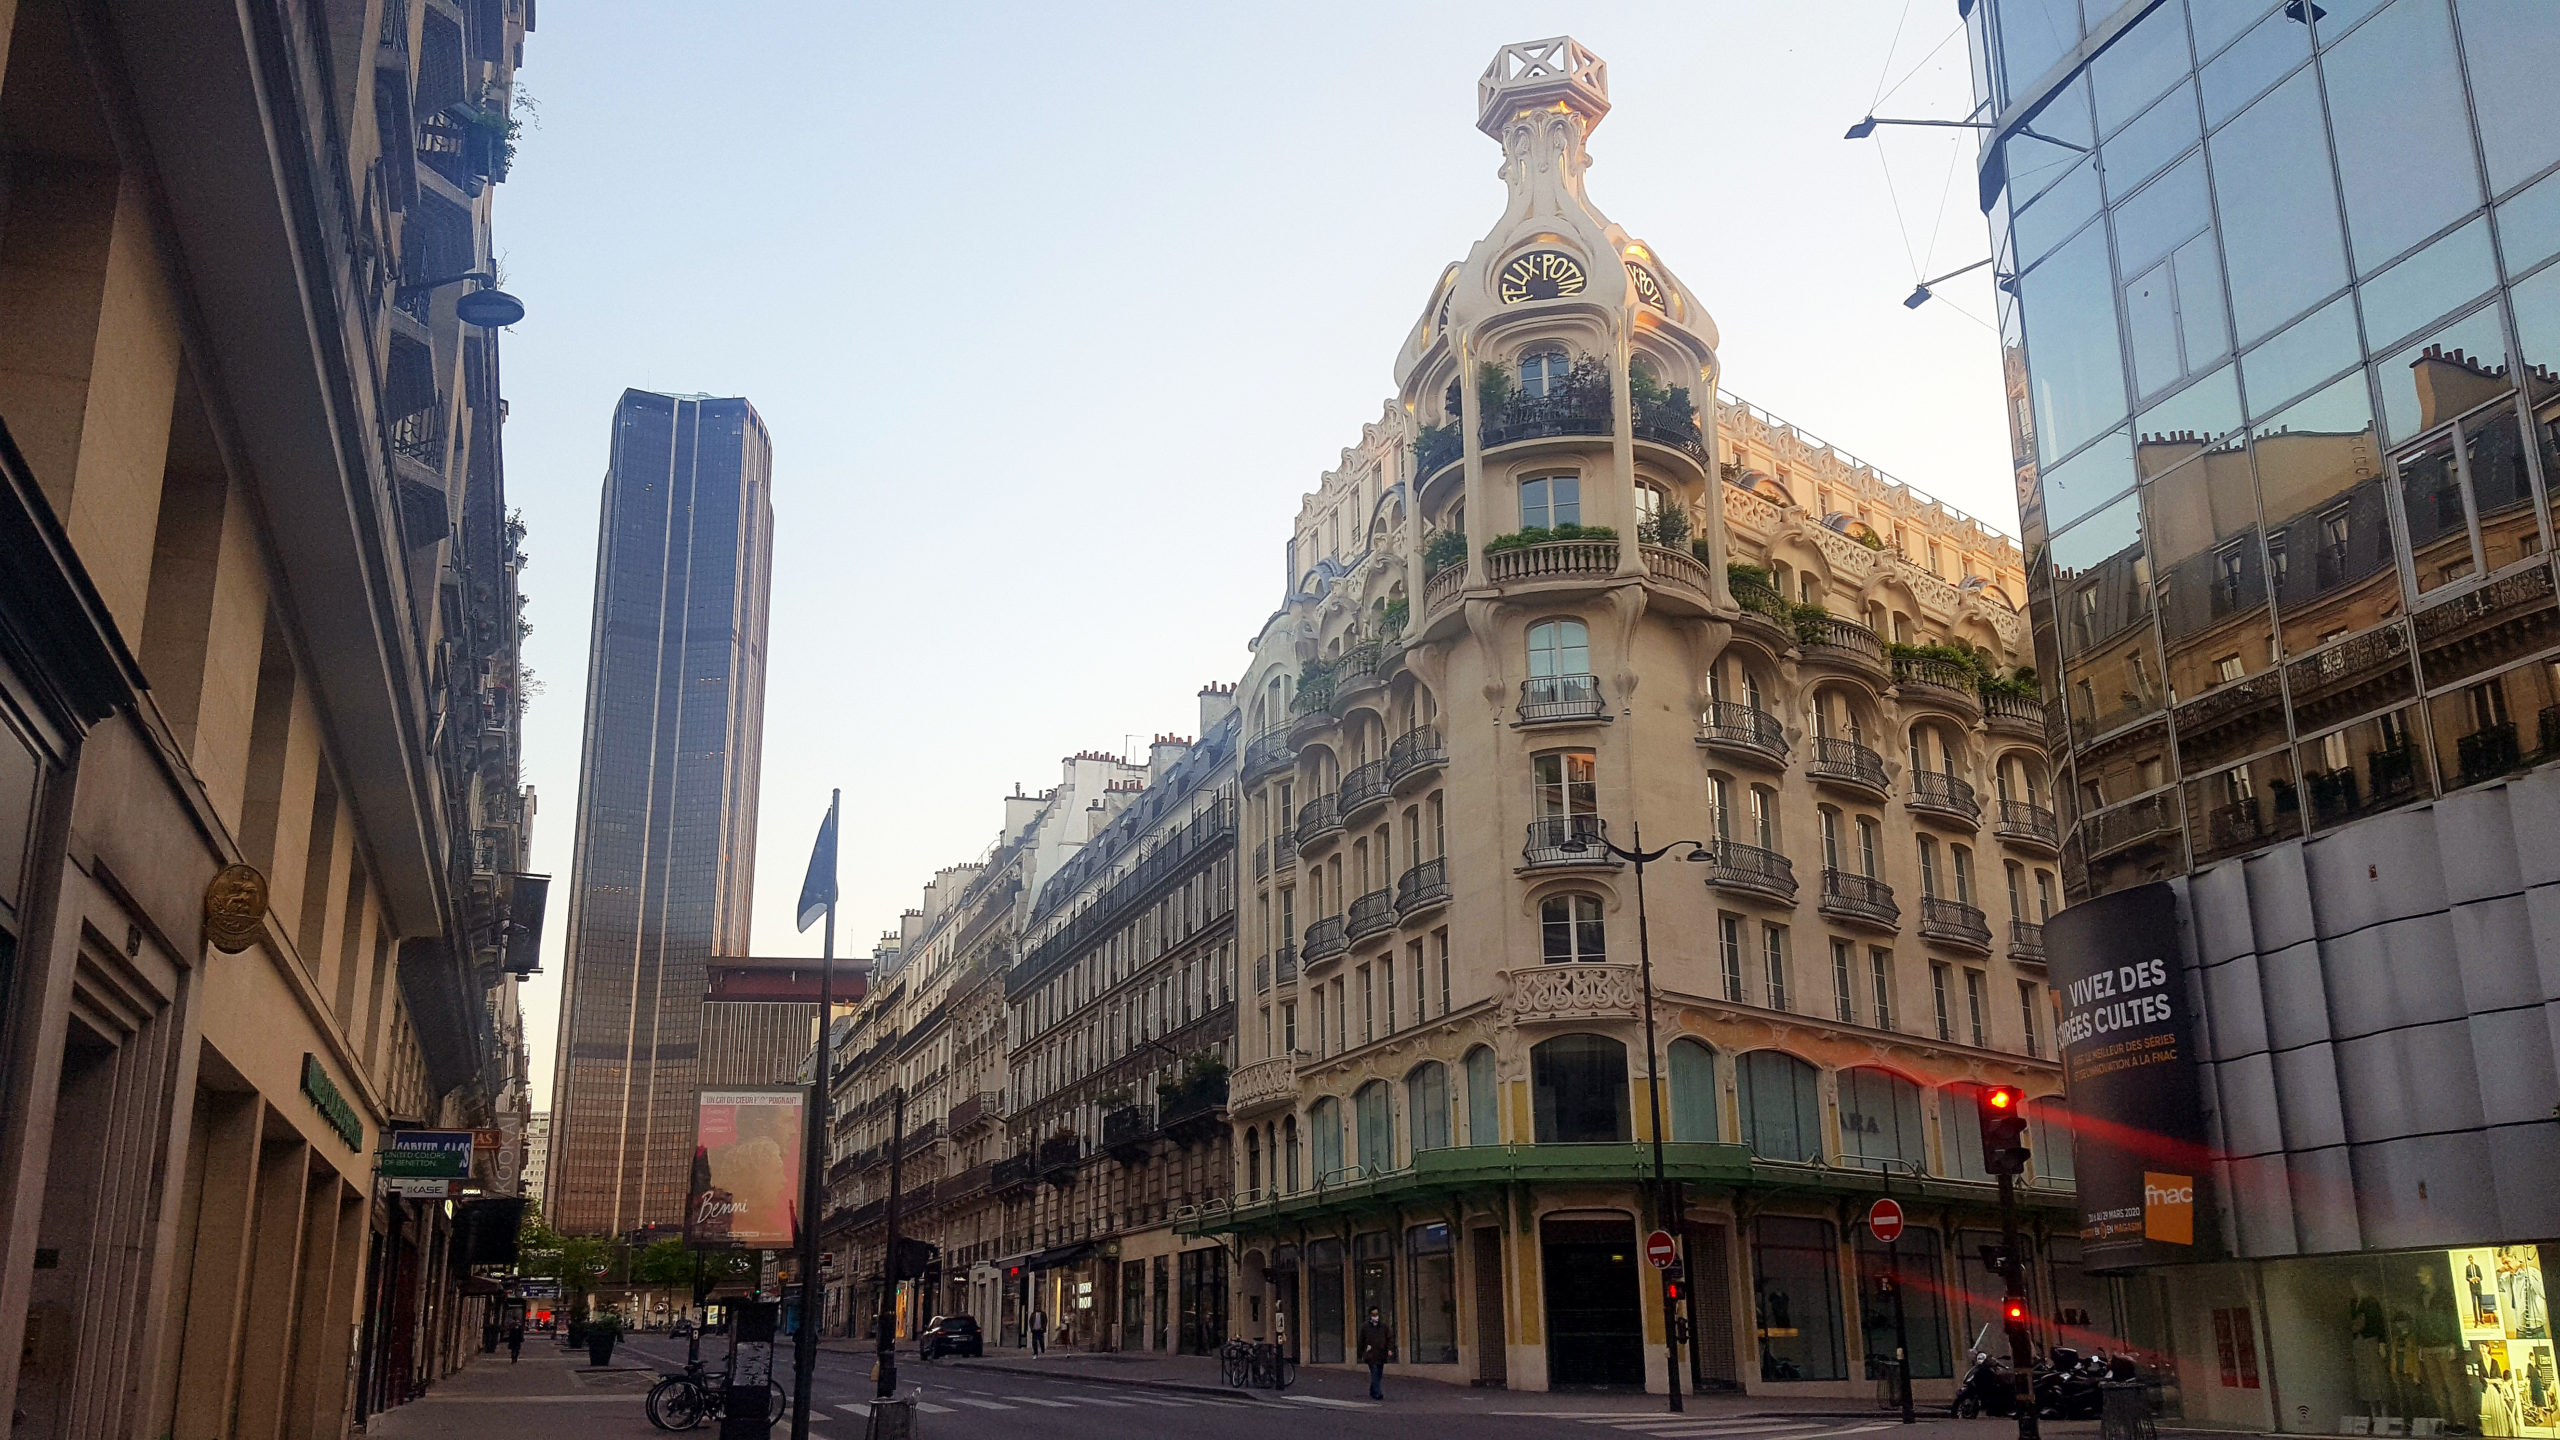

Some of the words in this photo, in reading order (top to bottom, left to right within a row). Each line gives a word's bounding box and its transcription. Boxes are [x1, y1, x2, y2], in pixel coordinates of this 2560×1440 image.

[1542, 253, 1585, 297] POTIN
[2068, 970, 2117, 1008] VIVEZ
[2119, 958, 2167, 993] DES
[2094, 993, 2172, 1034] CULTES
[2125, 1039, 2143, 1052] DES
[2140, 1053, 2151, 1065] LA
[2152, 1049, 2178, 1064] FNAC
[384, 1151, 413, 1159] UNITED
[414, 1151, 446, 1160] COLORS
[2145, 1185, 2192, 1206] fnac
[697, 1190, 749, 1224] Benni
[2125, 1206, 2140, 1217] 2020
